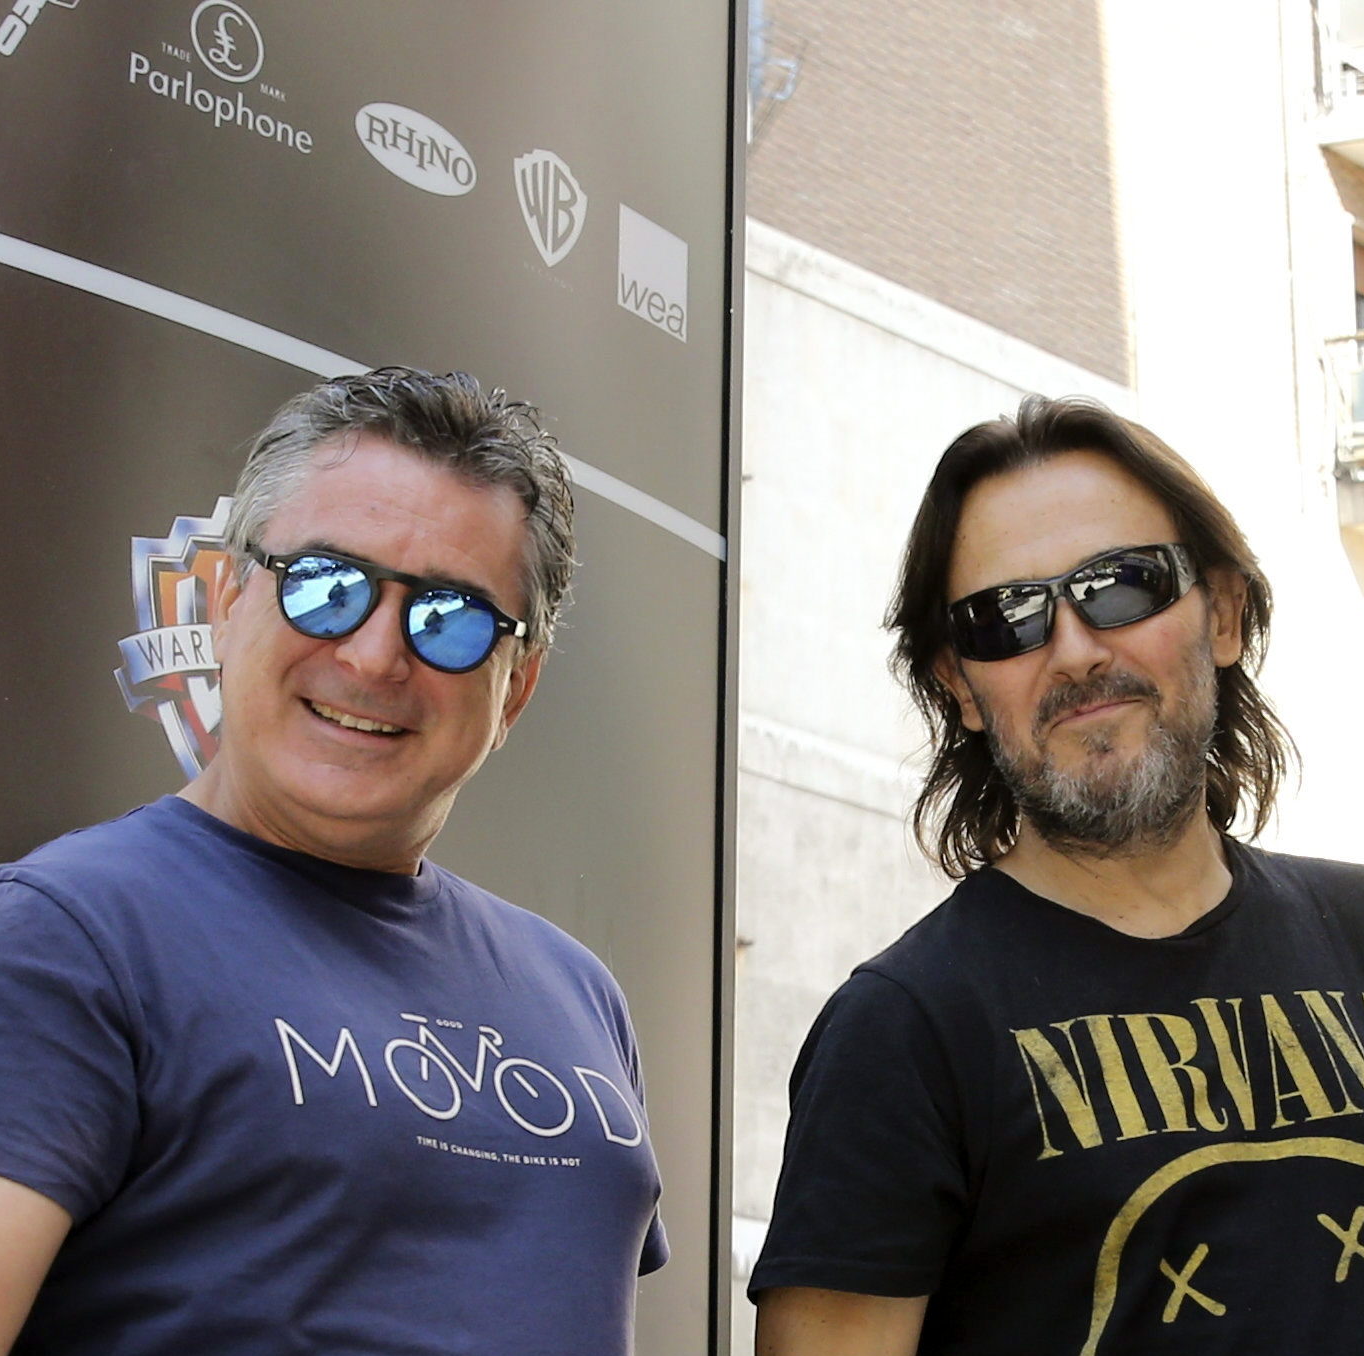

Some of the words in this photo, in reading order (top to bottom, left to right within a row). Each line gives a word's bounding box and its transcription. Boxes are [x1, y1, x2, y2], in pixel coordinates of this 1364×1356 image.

[161, 41, 191, 63] TRADE
[129, 51, 313, 154] Parlophone
[259, 83, 286, 102] MARK
[363, 111, 473, 186] RHINO
[520, 160, 578, 255] WB
[620, 272, 685, 337] wea
[135, 629, 214, 671] WAR
[435, 1018, 464, 1029] GOOD
[416, 1136, 438, 1149] TIME
[440, 1141, 449, 1151] IS
[450, 1144, 501, 1162] CHANGING,
[503, 1153, 521, 1163] THE
[523, 1155, 546, 1166] BIKE
[549, 1157, 559, 1166] IS
[561, 1158, 581, 1167] NOT
